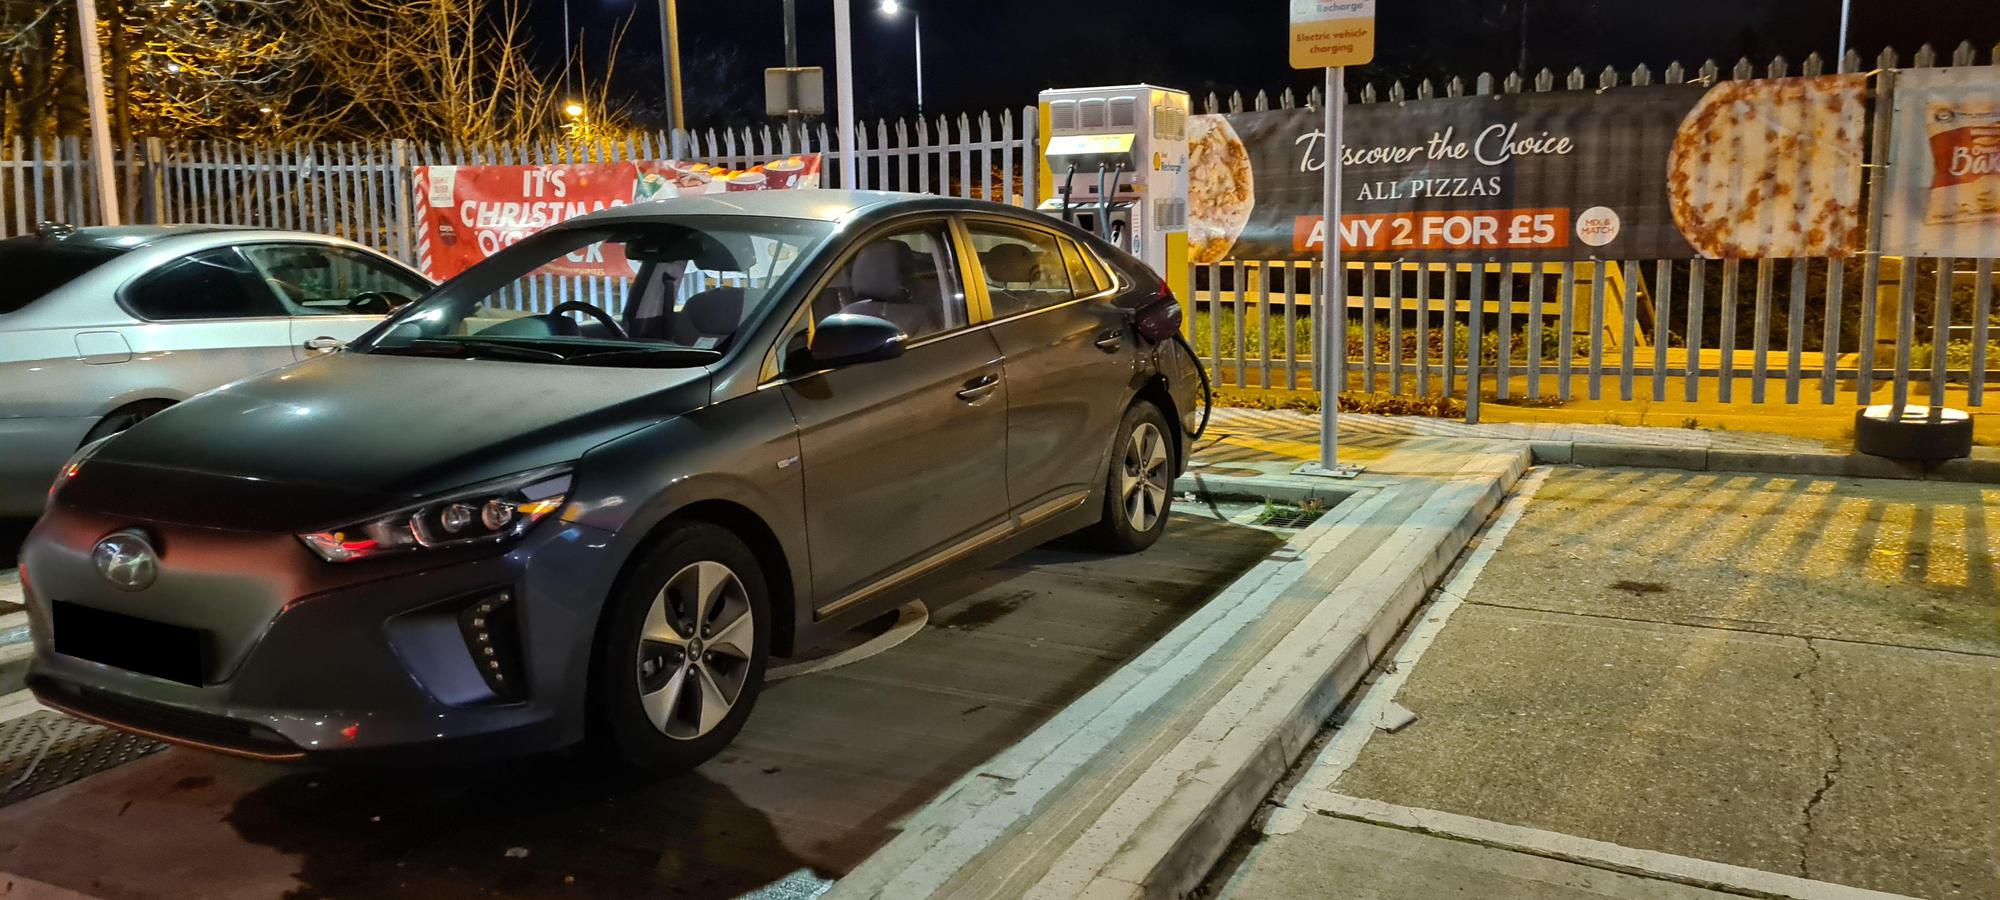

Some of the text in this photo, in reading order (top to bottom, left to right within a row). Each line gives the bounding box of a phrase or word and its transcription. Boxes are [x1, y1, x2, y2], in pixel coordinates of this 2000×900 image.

[1316, 2, 1364, 13] Recharge
[1296, 27, 1367, 42] Electric vehicle
[1310, 43, 1353, 54] charging
[1427, 126, 1469, 160] the
[1474, 122, 1573, 166] Choice
[523, 169, 567, 198] IT'S
[1357, 176, 1501, 201] ALL PIZZAS
[1305, 213, 1555, 248] ANY 2 FOR £5
